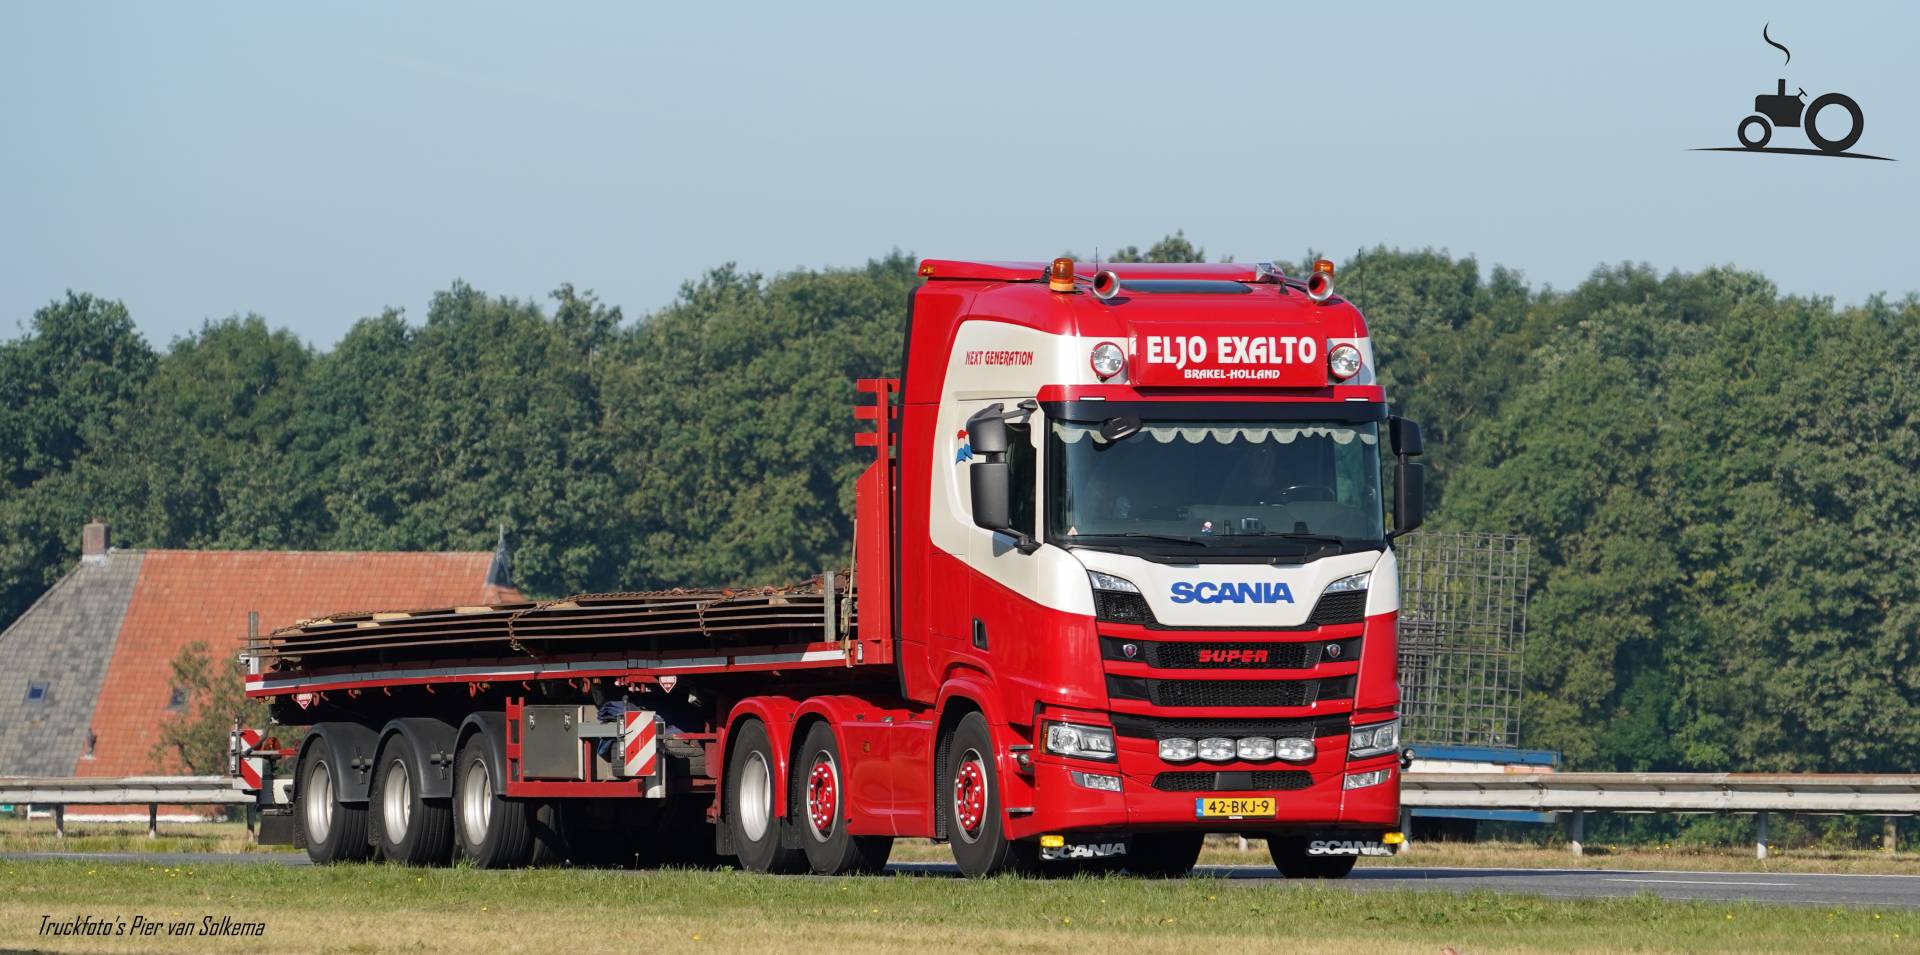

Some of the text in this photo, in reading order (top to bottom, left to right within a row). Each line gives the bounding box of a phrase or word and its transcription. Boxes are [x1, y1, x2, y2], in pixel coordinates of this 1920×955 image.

[965, 350, 1034, 366] NEXT GENERATION
[1146, 335, 1317, 370] ELJO EXALTO
[1184, 369, 1281, 380] BRAKEL-HOLLAND
[1170, 581, 1295, 604] SCANIA
[1199, 649, 1268, 663] SUPER
[1208, 800, 1270, 814] 42-BKJ-9
[1041, 843, 1127, 860] SCANIA
[1308, 840, 1394, 855] SCANIA
